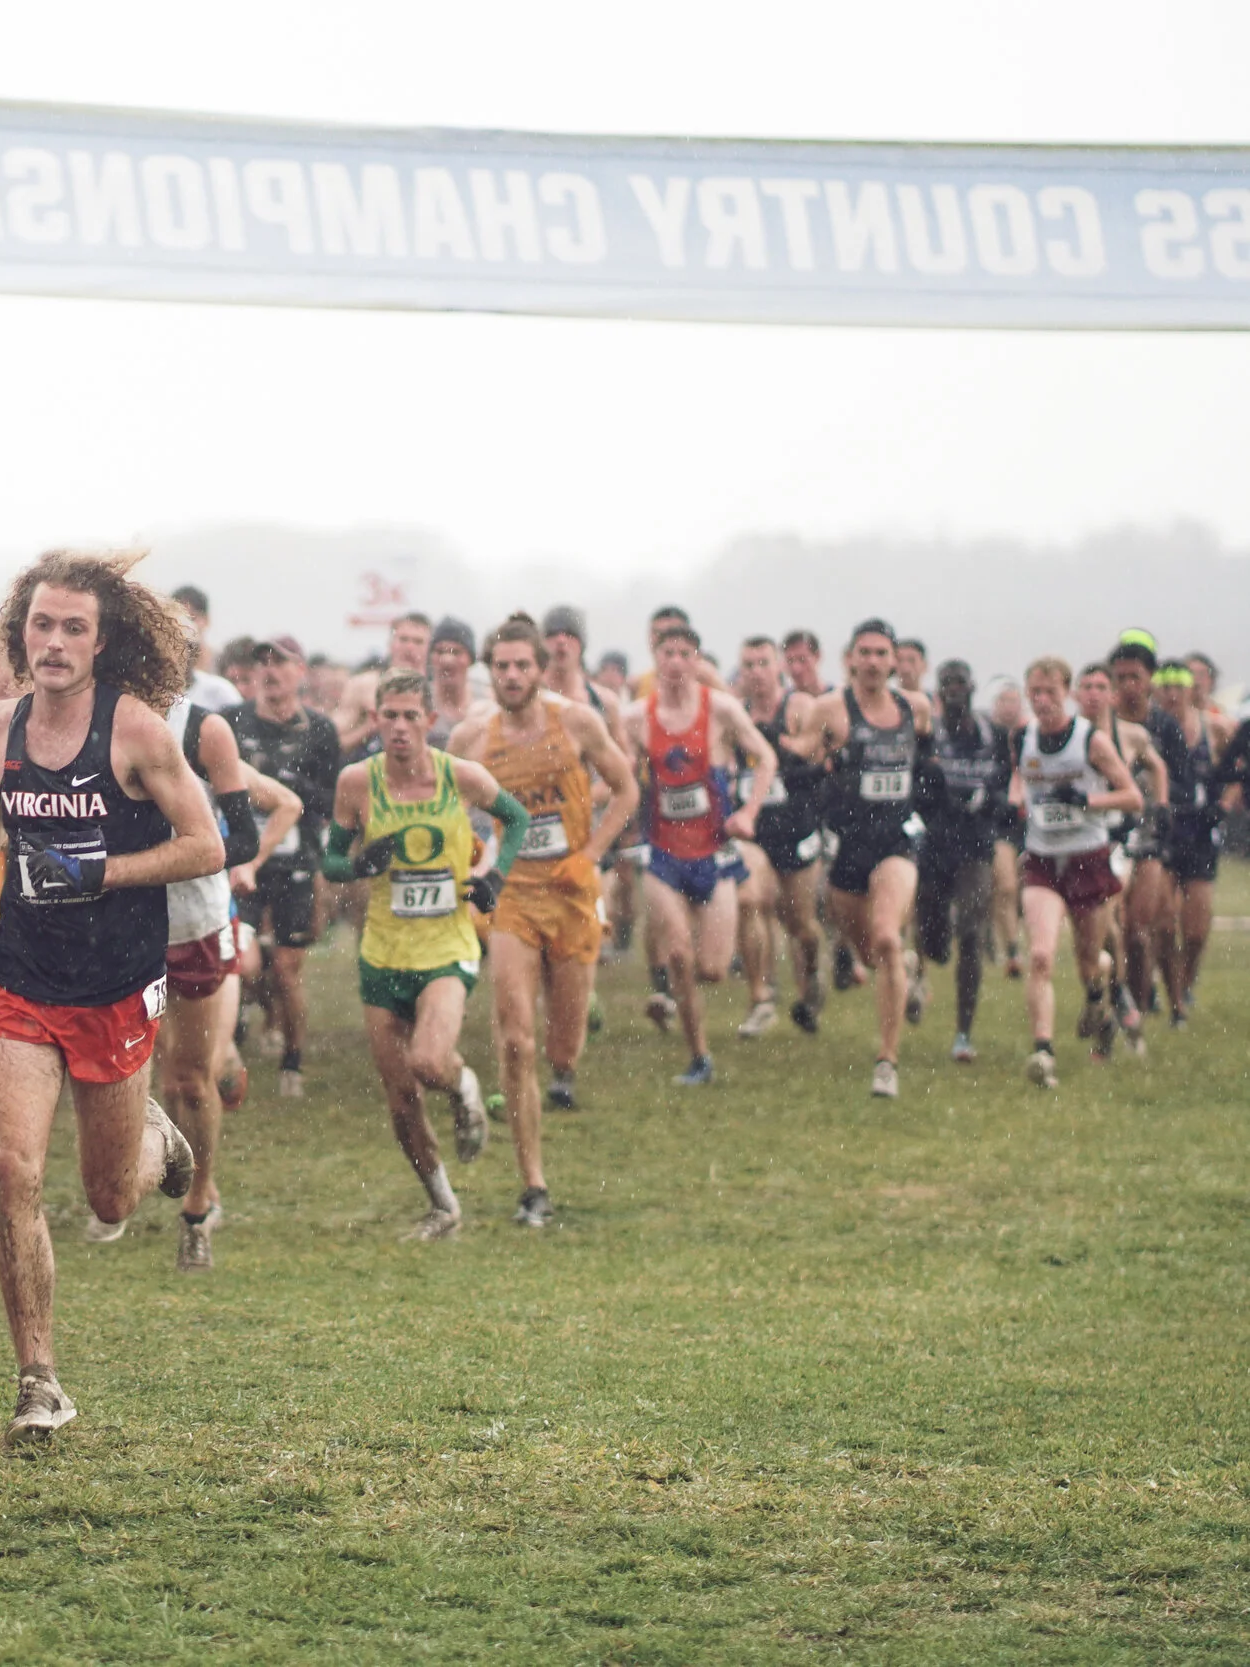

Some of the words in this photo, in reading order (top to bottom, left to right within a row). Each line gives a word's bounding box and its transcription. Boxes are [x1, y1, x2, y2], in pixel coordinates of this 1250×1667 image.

[0, 791, 109, 818] VIRGINIA
[394, 824, 445, 866] O
[404, 885, 441, 908] 677
